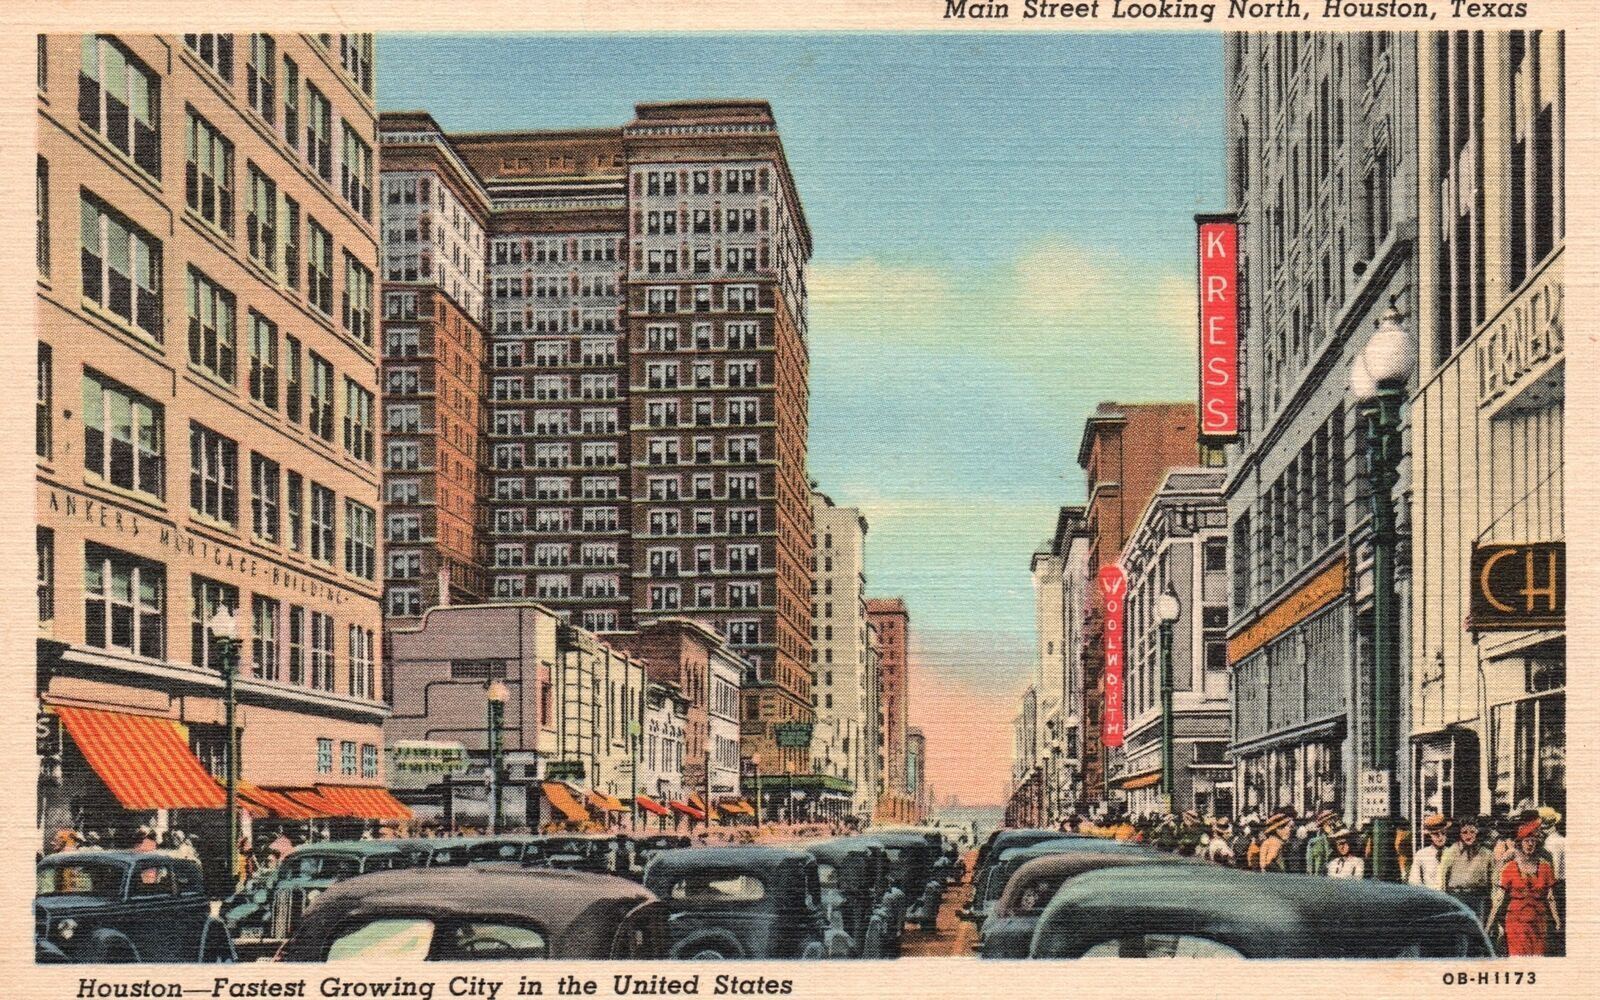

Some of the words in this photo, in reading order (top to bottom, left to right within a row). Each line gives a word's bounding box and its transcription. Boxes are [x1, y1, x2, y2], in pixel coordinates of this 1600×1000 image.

[1206, 230, 1230, 429] KRESS
[1102, 576, 1122, 735] WOOLWORTH
[1479, 547, 1557, 614] CH
